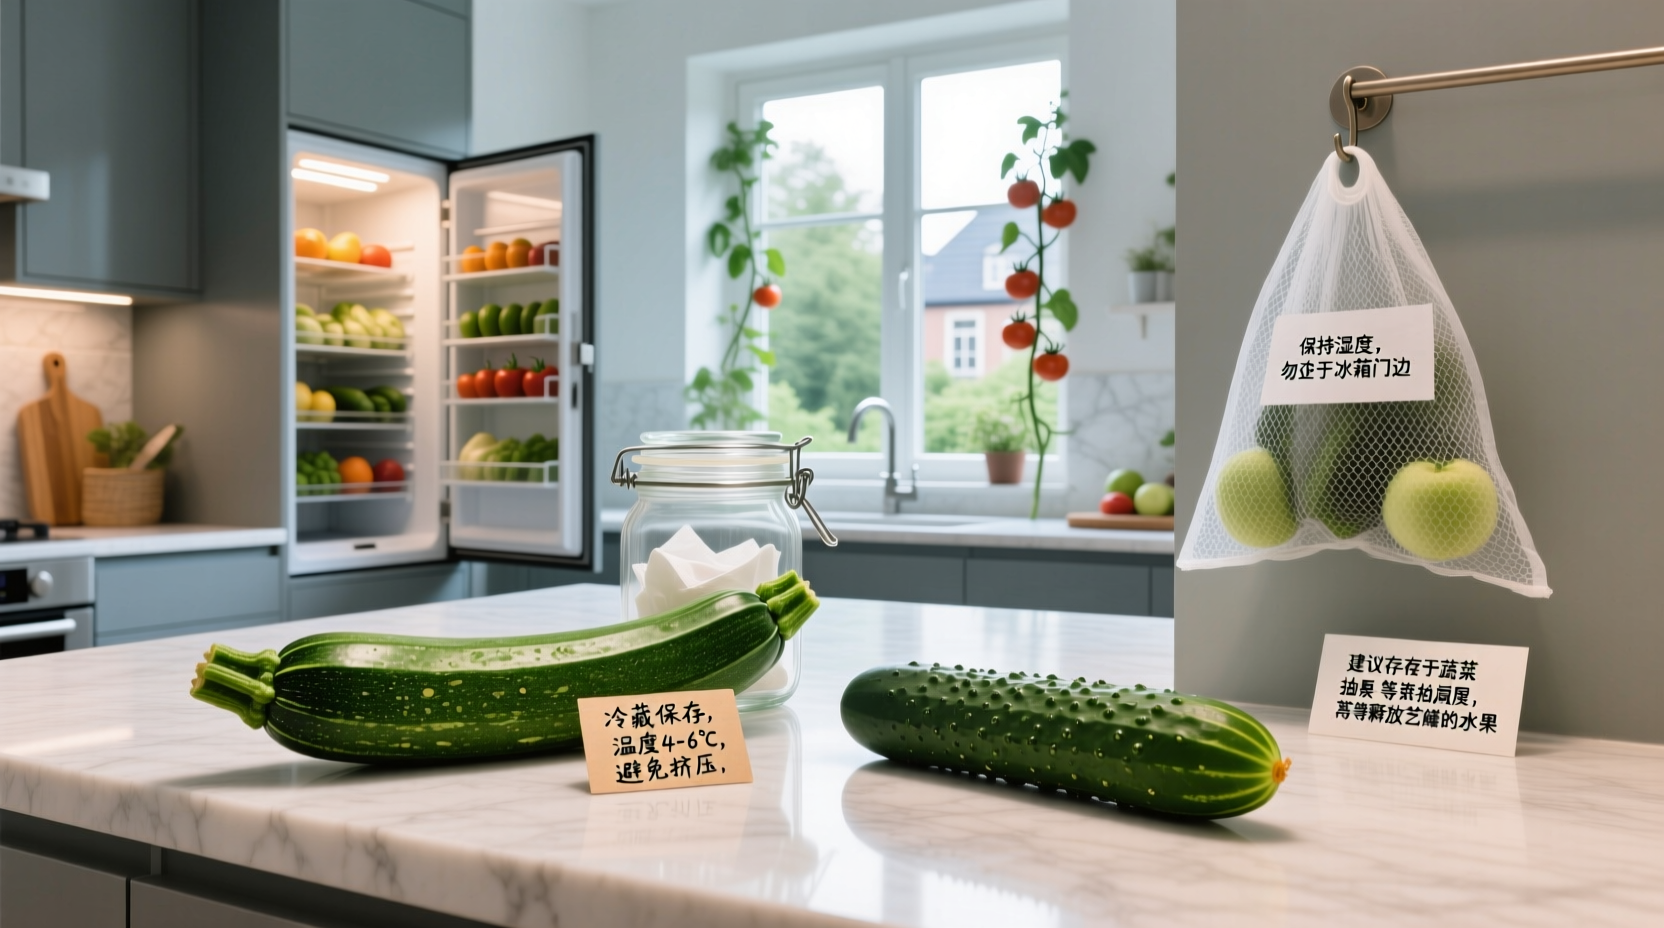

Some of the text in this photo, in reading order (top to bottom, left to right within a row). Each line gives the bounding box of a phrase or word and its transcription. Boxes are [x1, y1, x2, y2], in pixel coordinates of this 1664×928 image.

[604, 701, 713, 728] 冷藏保存，
[616, 754, 726, 783] 避免挤压，
